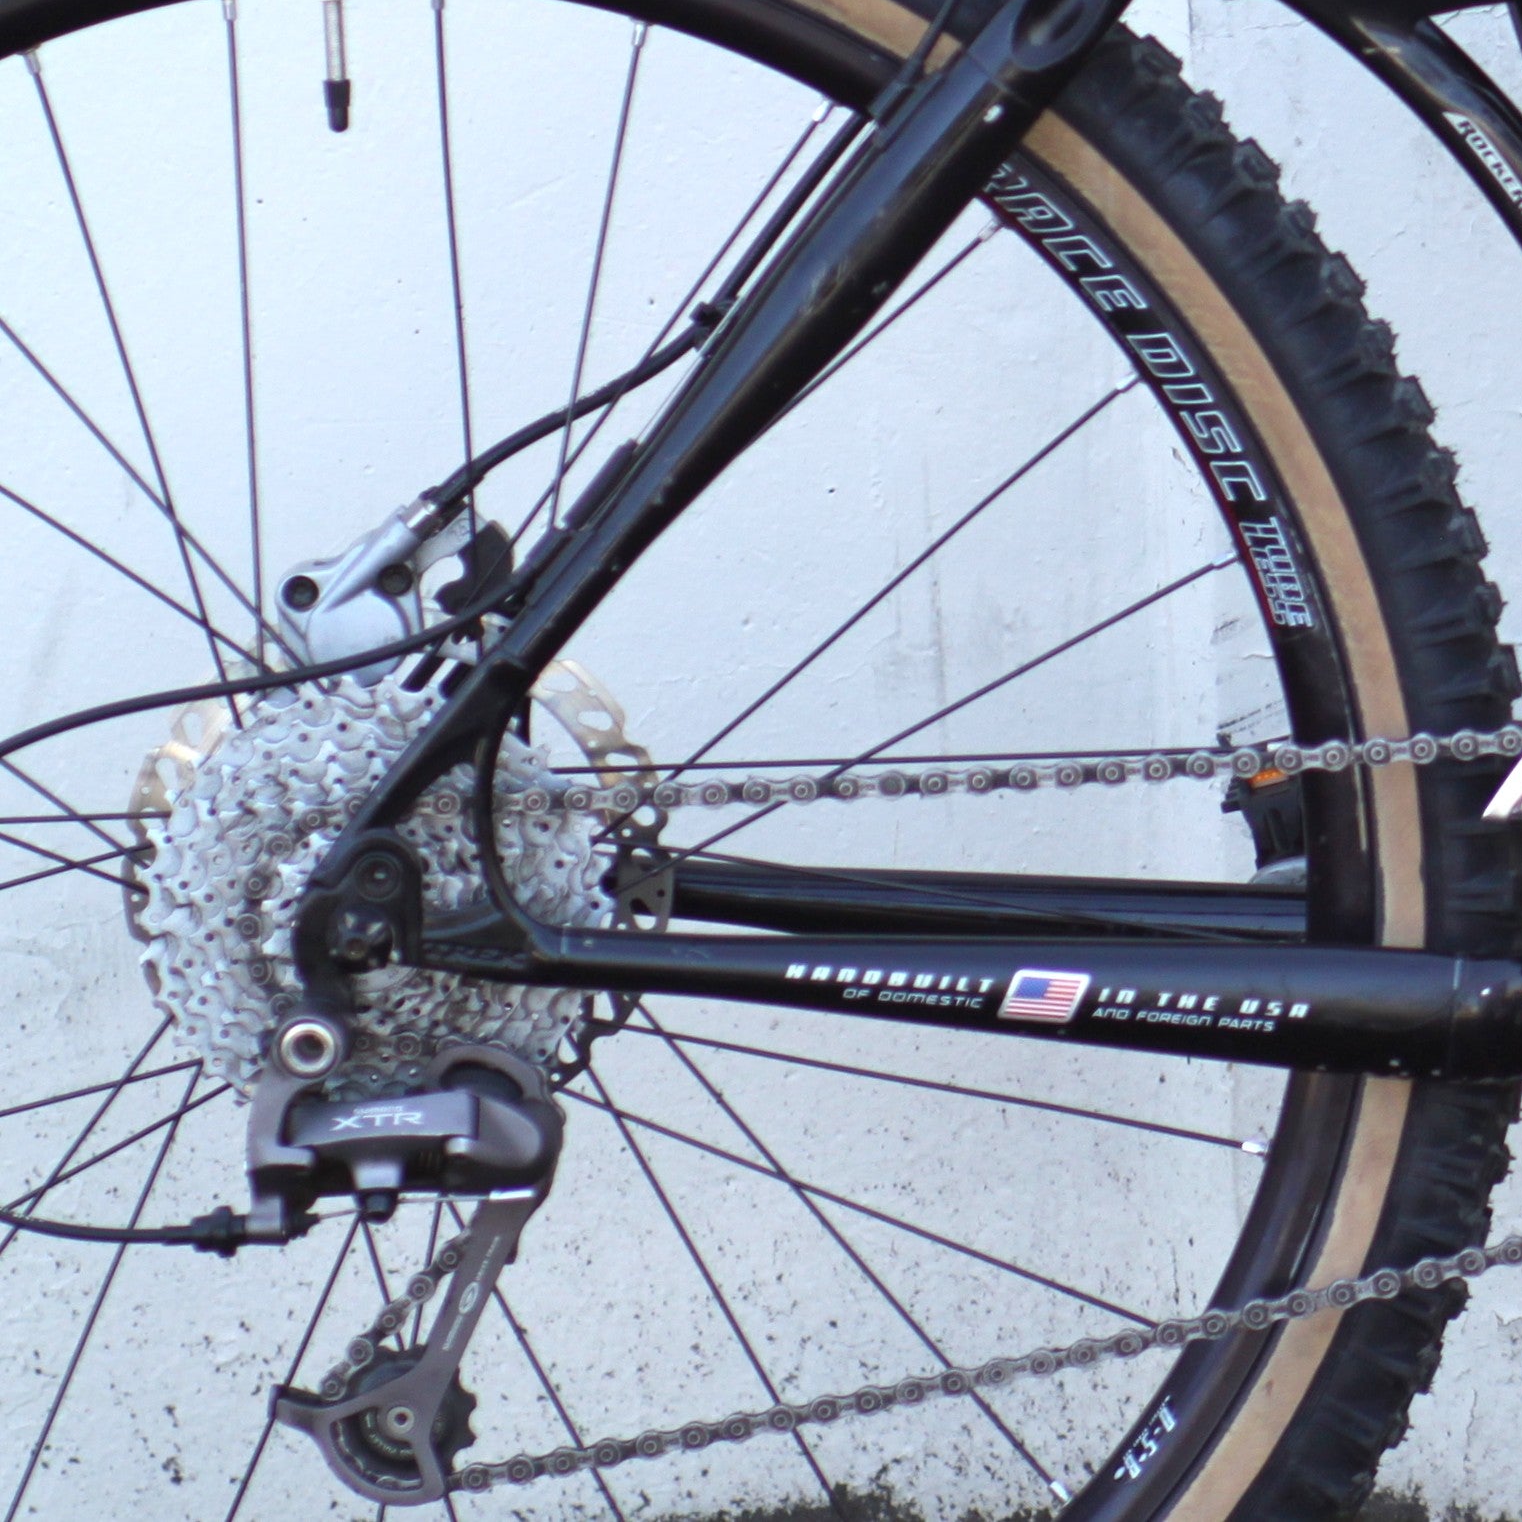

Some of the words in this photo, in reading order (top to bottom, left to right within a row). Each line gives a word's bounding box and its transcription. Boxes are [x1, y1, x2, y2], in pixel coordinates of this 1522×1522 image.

[1126, 332, 1268, 503] DISC
[784, 964, 995, 994] HANDBUILT
[1097, 987, 1136, 1005] IN
[1157, 991, 1220, 1012] THE
[1239, 998, 1311, 1019] USA
[842, 988, 871, 1000] OF
[877, 989, 985, 1009] DOMESTIC
[1091, 1007, 1130, 1021] AND
[1135, 1010, 1212, 1027] FOREIGN
[1217, 1015, 1276, 1032] PARTS
[329, 1110, 424, 1132] XTR
